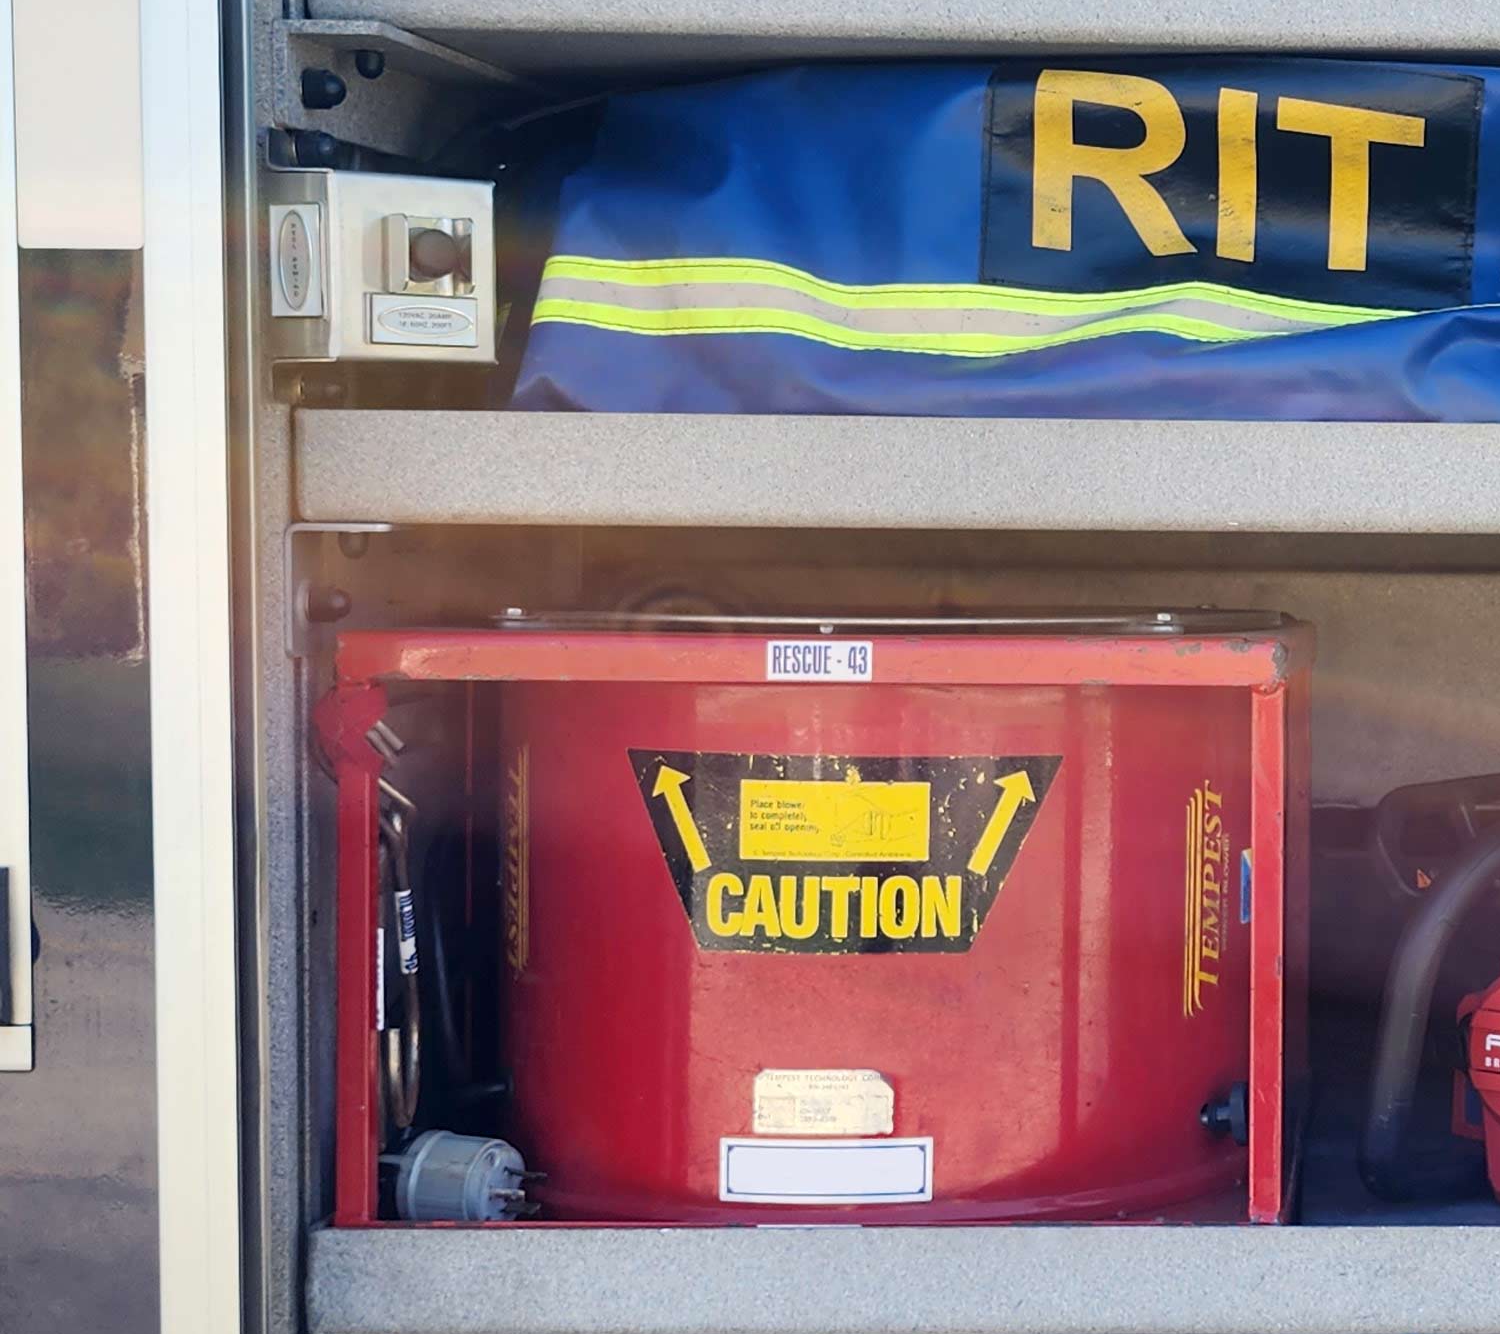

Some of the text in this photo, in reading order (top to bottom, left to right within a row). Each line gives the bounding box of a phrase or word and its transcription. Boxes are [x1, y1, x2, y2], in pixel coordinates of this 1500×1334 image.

[1031, 69, 1426, 272] RIT
[772, 645, 832, 675] RESCUE
[848, 646, 868, 675] 43
[750, 799, 774, 809] Place
[750, 823, 769, 831] seal
[706, 872, 963, 940] CAUTION
[1195, 779, 1224, 993] TEMPEST
